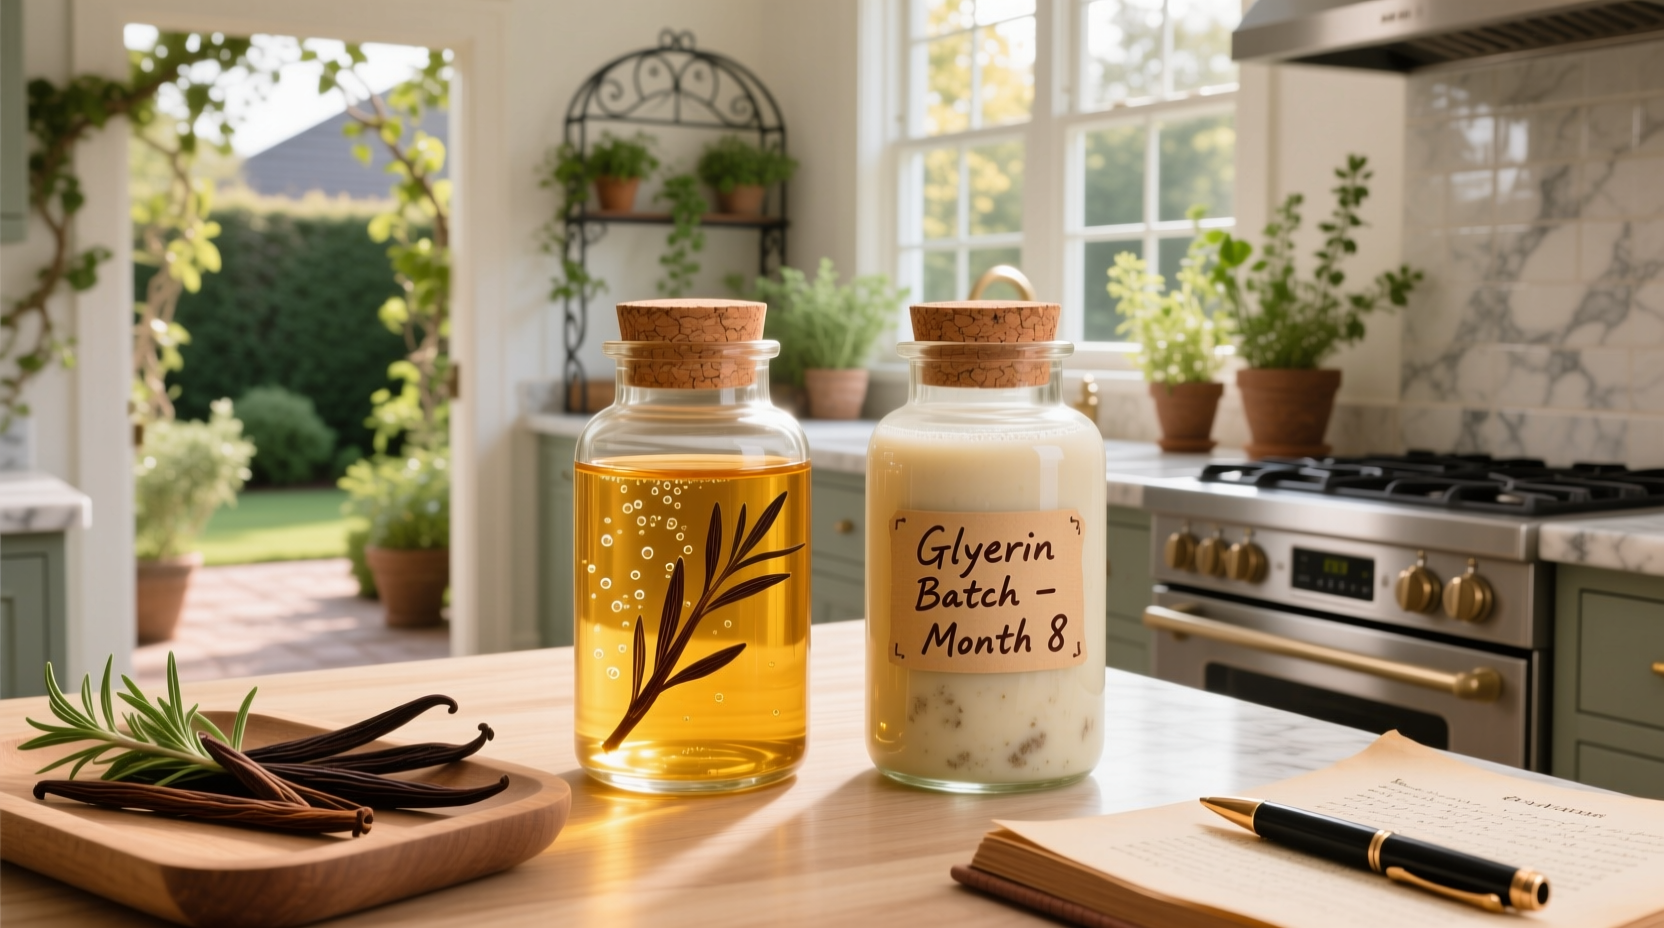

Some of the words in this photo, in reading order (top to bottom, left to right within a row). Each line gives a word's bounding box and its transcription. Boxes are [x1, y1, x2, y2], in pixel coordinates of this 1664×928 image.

[916, 525, 1055, 579] Glyerin
[915, 575, 1020, 611] Batch
[921, 618, 1032, 658] Month
[1048, 613, 1068, 653] 8
